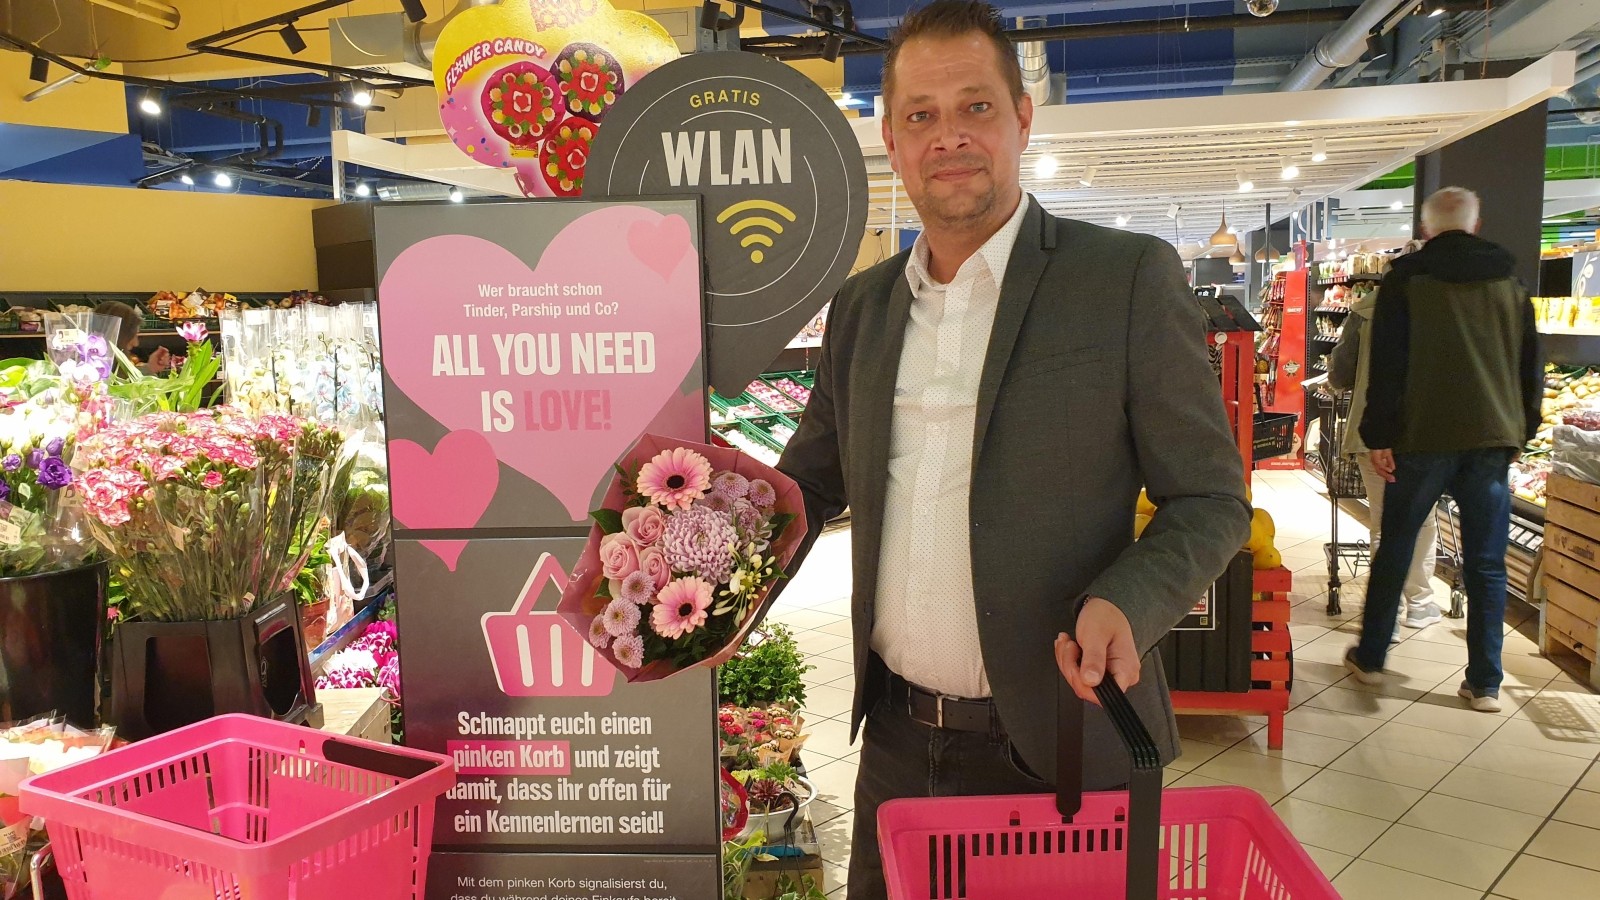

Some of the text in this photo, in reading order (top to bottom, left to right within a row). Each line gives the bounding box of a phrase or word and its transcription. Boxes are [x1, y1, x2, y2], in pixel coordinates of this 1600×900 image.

[494, 39, 544, 57] CANDY
[689, 89, 760, 108] GRATIS
[661, 128, 792, 187] WLAN
[478, 283, 602, 298] Wer braucht schon
[463, 302, 619, 319] Tinder, Parship und Co?
[432, 332, 656, 377] ALL YOU NEED
[480, 389, 612, 432] IS LOVE!
[457, 711, 652, 740] Schnappt euch einen
[453, 744, 661, 773] pinken Korb und zeigt
[507, 777, 552, 801] dass
[557, 777, 583, 801] ihr
[588, 777, 637, 801] offen
[641, 778, 671, 801] für
[454, 809, 664, 834] ein Kennenlernen seid!
[457, 876, 667, 891] Mit dem pinken Korb signalisierst du,
